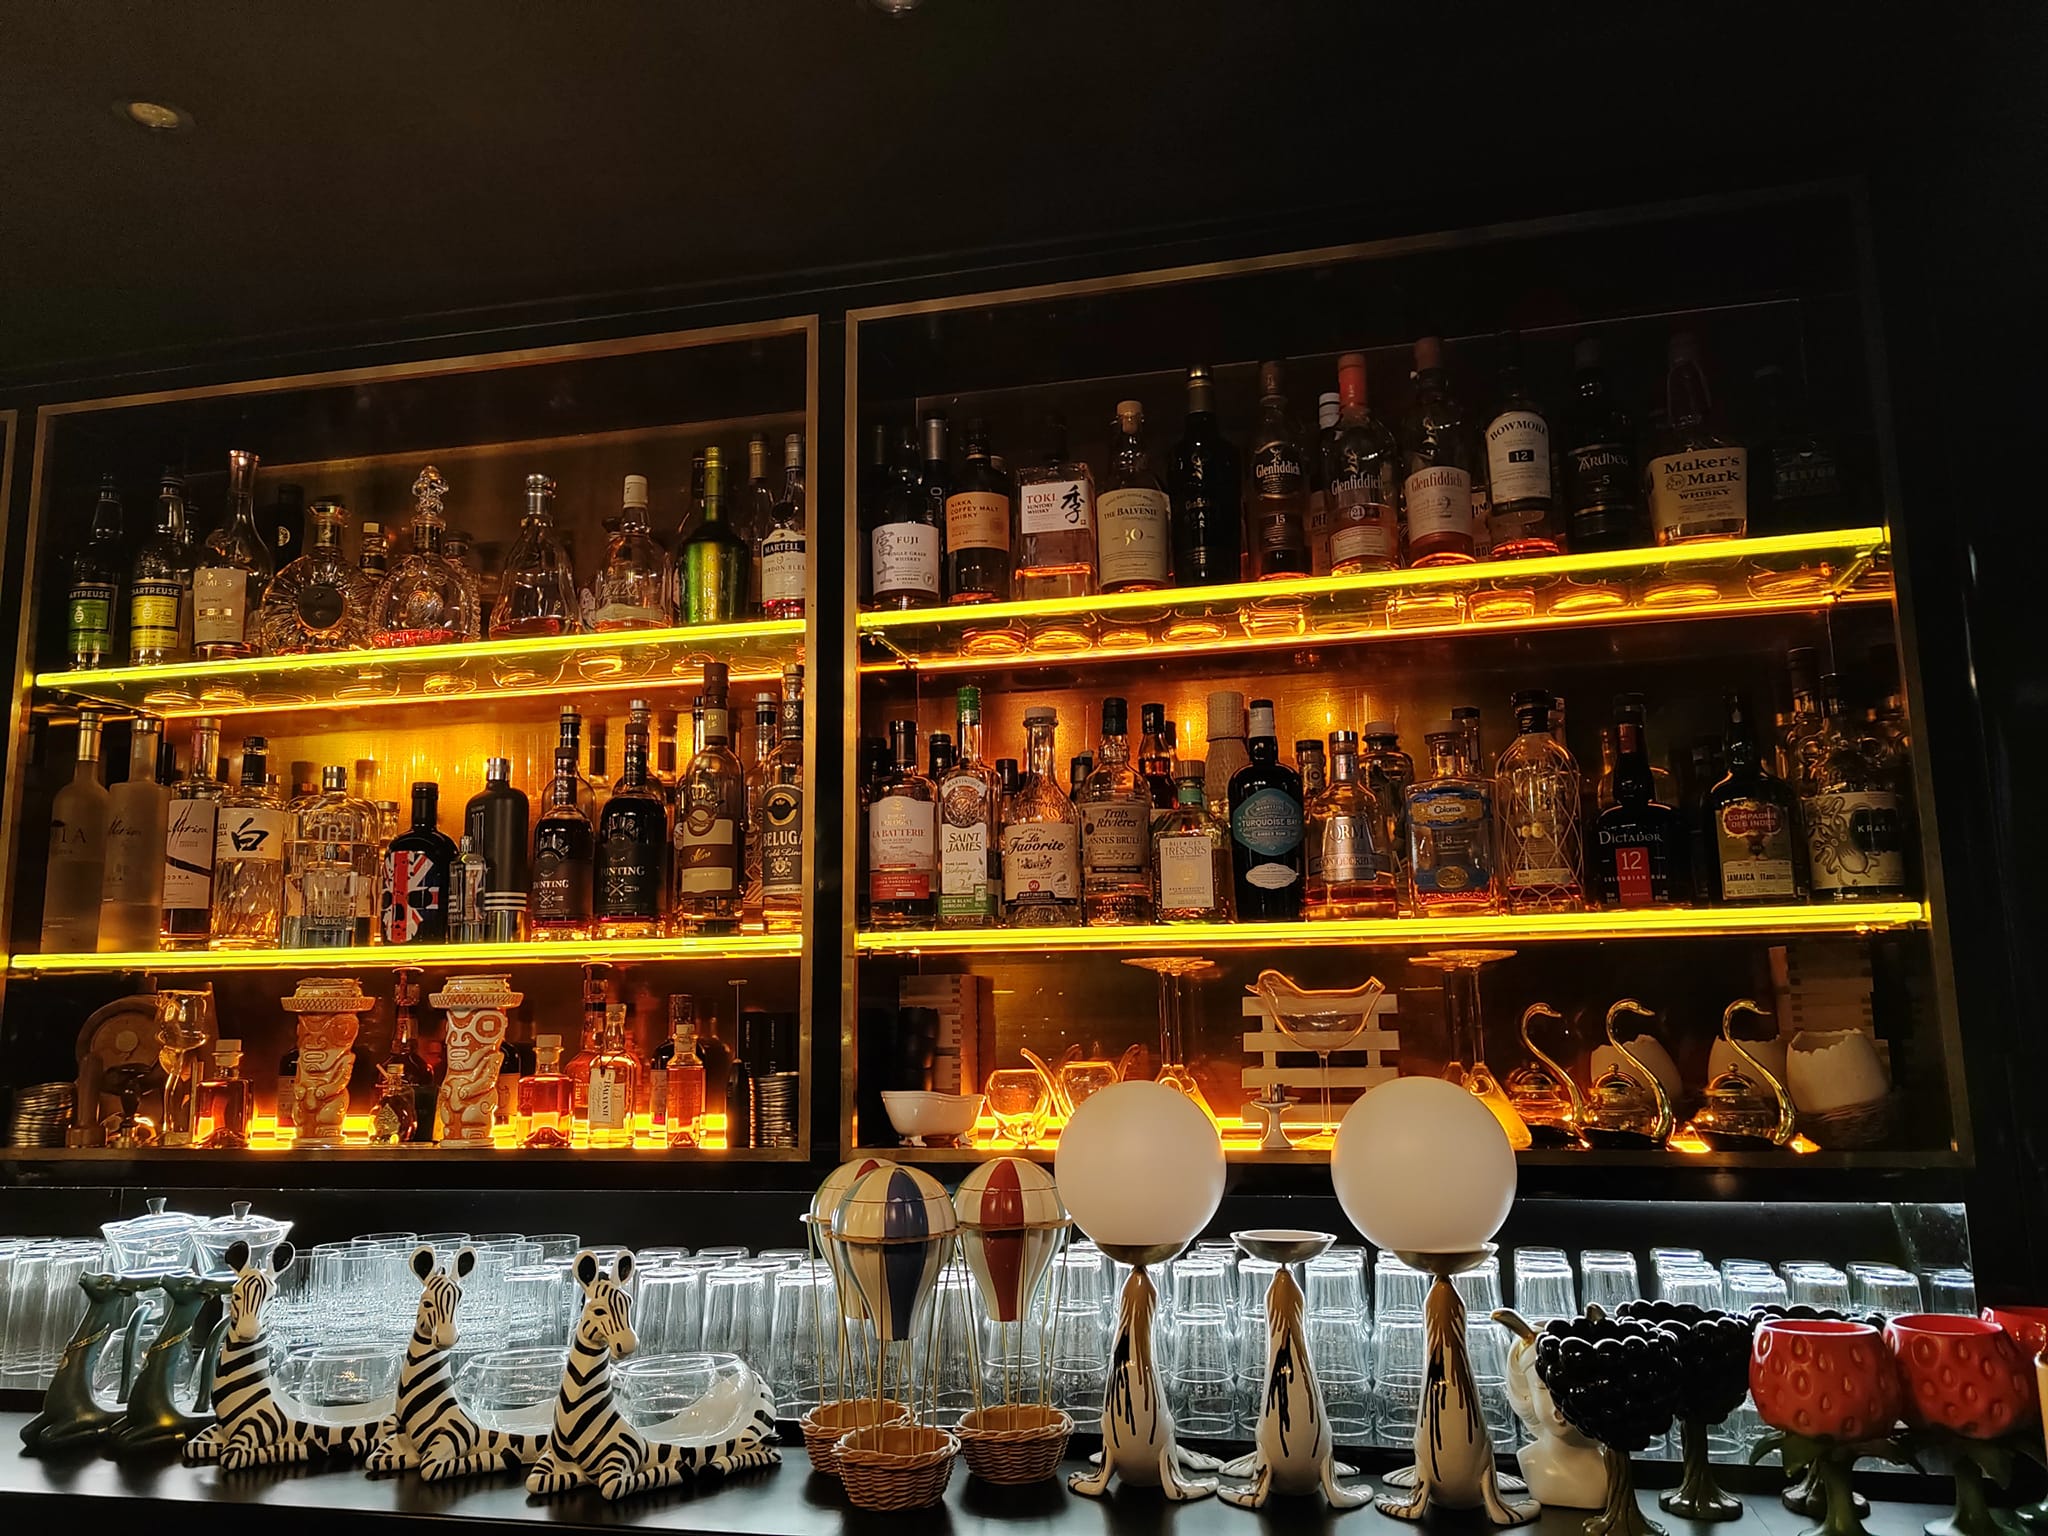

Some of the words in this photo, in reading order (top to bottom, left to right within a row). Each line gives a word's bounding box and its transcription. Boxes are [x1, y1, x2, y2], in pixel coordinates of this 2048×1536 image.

[1514, 450, 1529, 462] 12
[1255, 460, 1301, 479] Glenfiddich
[1664, 455, 1741, 475] Maker's
[1411, 470, 1463, 493] Glenfiddich
[1687, 470, 1741, 487] Mark
[1026, 493, 1056, 504] TOKI
[1679, 488, 1731, 501] WHISKY
[950, 499, 973, 508] NIKKA
[1274, 513, 1287, 526] 15
[896, 536, 919, 545] FUJI
[765, 541, 801, 552] MARTELL
[68, 589, 112, 600] ARTREUSE
[1104, 808, 1129, 818] Trois
[1433, 805, 1462, 815] Coloma
[882, 828, 925, 838] BATTERIE
[948, 833, 982, 843] SAINT
[1026, 832, 1041, 843] La
[945, 842, 983, 853] JAMES
[1007, 837, 1066, 856] Favorite
[1621, 850, 1643, 871] 12
[1726, 873, 1756, 882] JAMAICA
